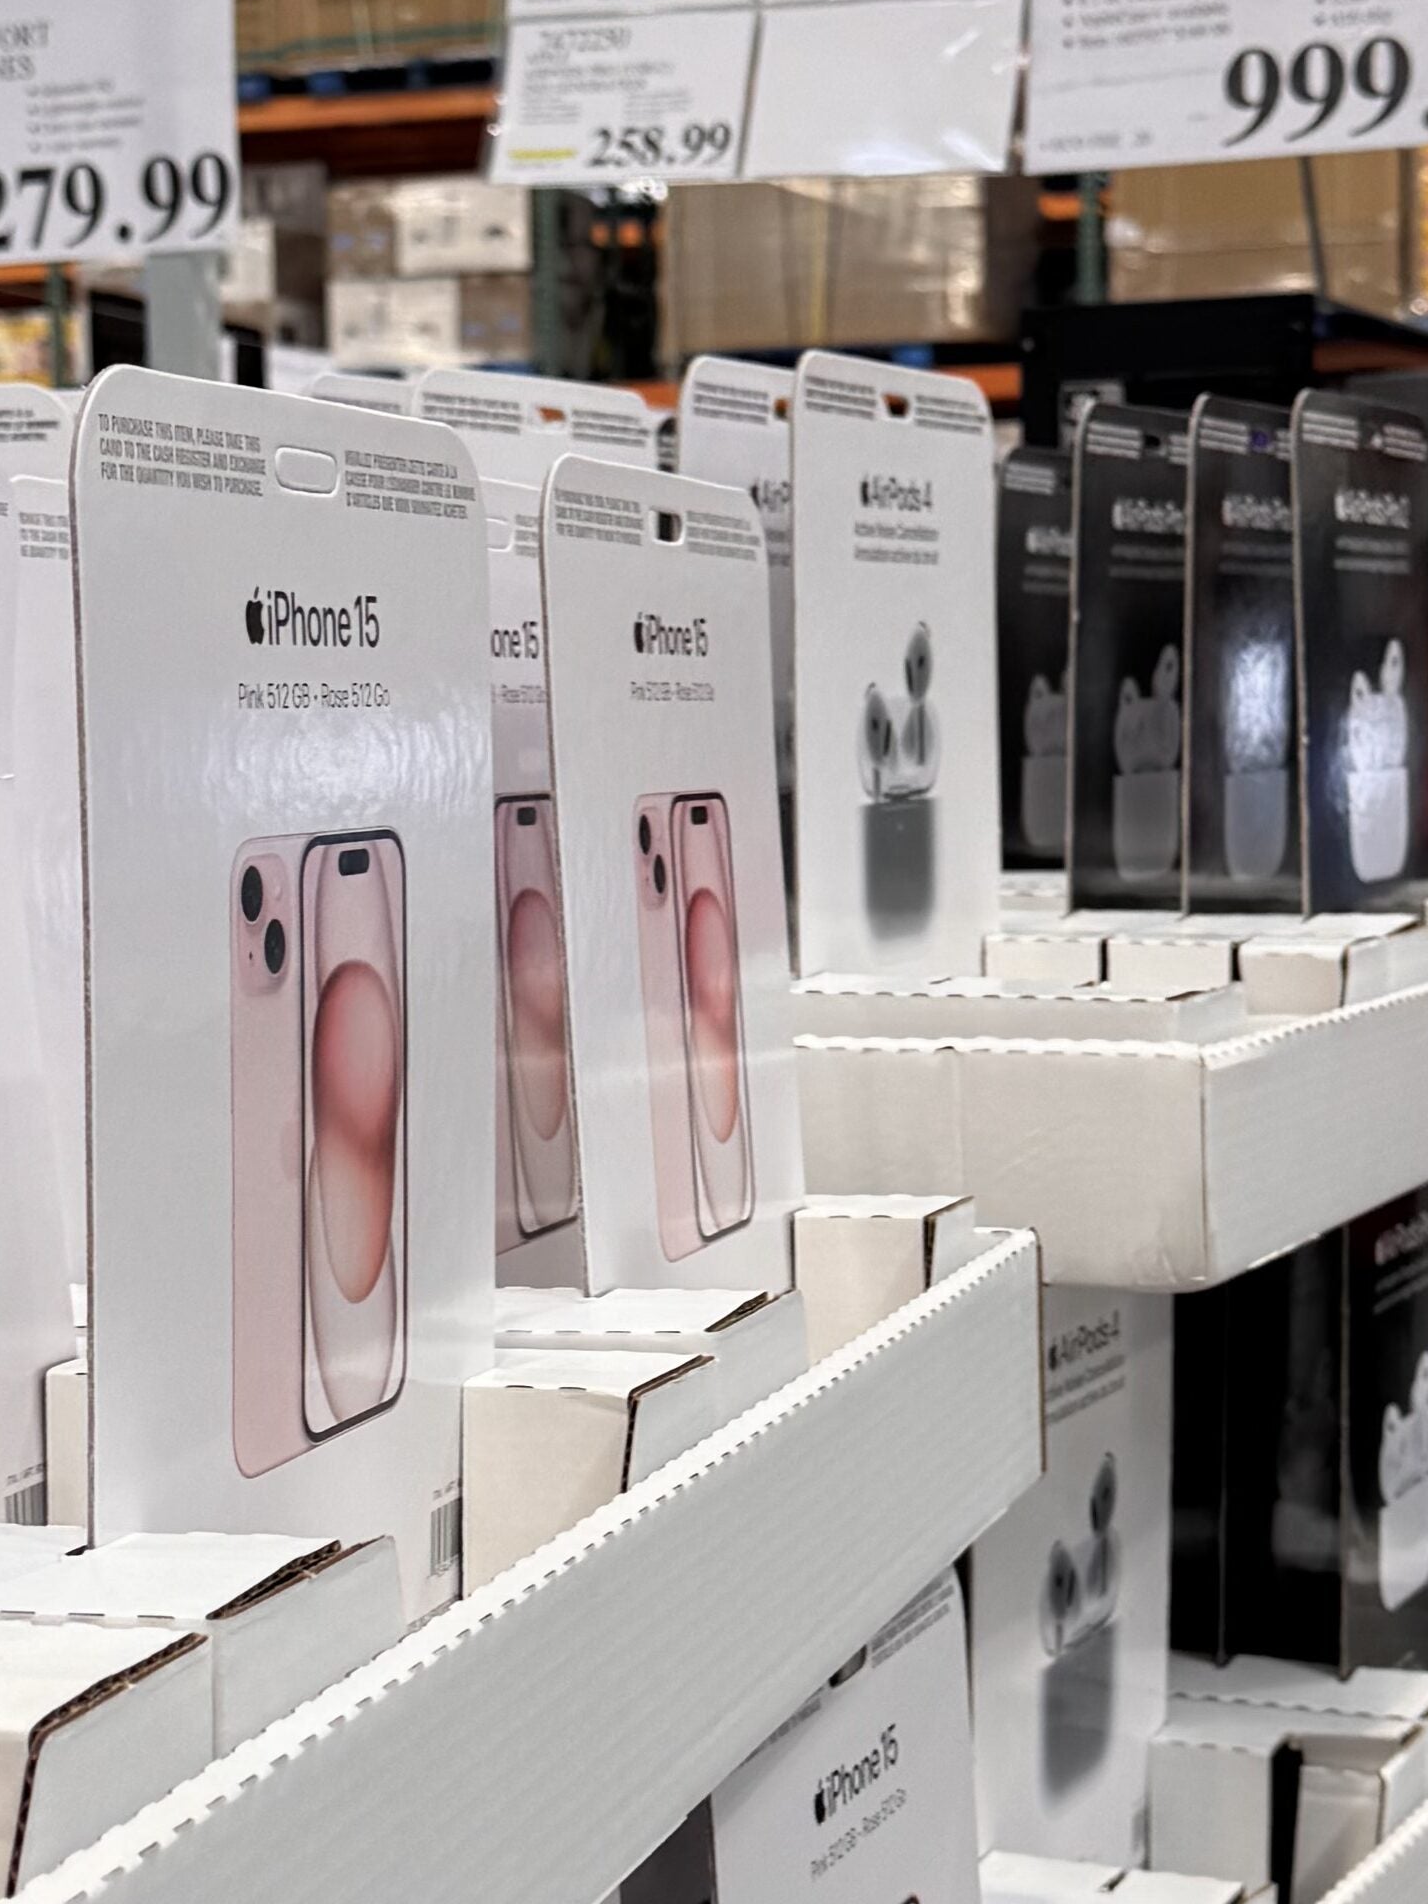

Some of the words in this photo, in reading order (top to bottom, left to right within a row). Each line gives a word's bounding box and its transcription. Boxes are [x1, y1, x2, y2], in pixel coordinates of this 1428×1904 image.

[584, 121, 731, 167] 258.99
[872, 476, 921, 512] AirPods
[923, 481, 933, 511] 4
[267, 590, 351, 648] iPhone
[354, 595, 380, 649] 15
[523, 621, 539, 659] 15
[645, 613, 692, 655] iPhone
[693, 617, 709, 657] 15
[238, 682, 265, 710] Pink
[266, 683, 290, 710] 512
[292, 683, 310, 709] GB
[321, 684, 349, 709] Rose
[351, 682, 372, 708] 512
[373, 683, 390, 708] Go
[826, 1748, 881, 1818] iPhone
[881, 1724, 899, 1771] 15
